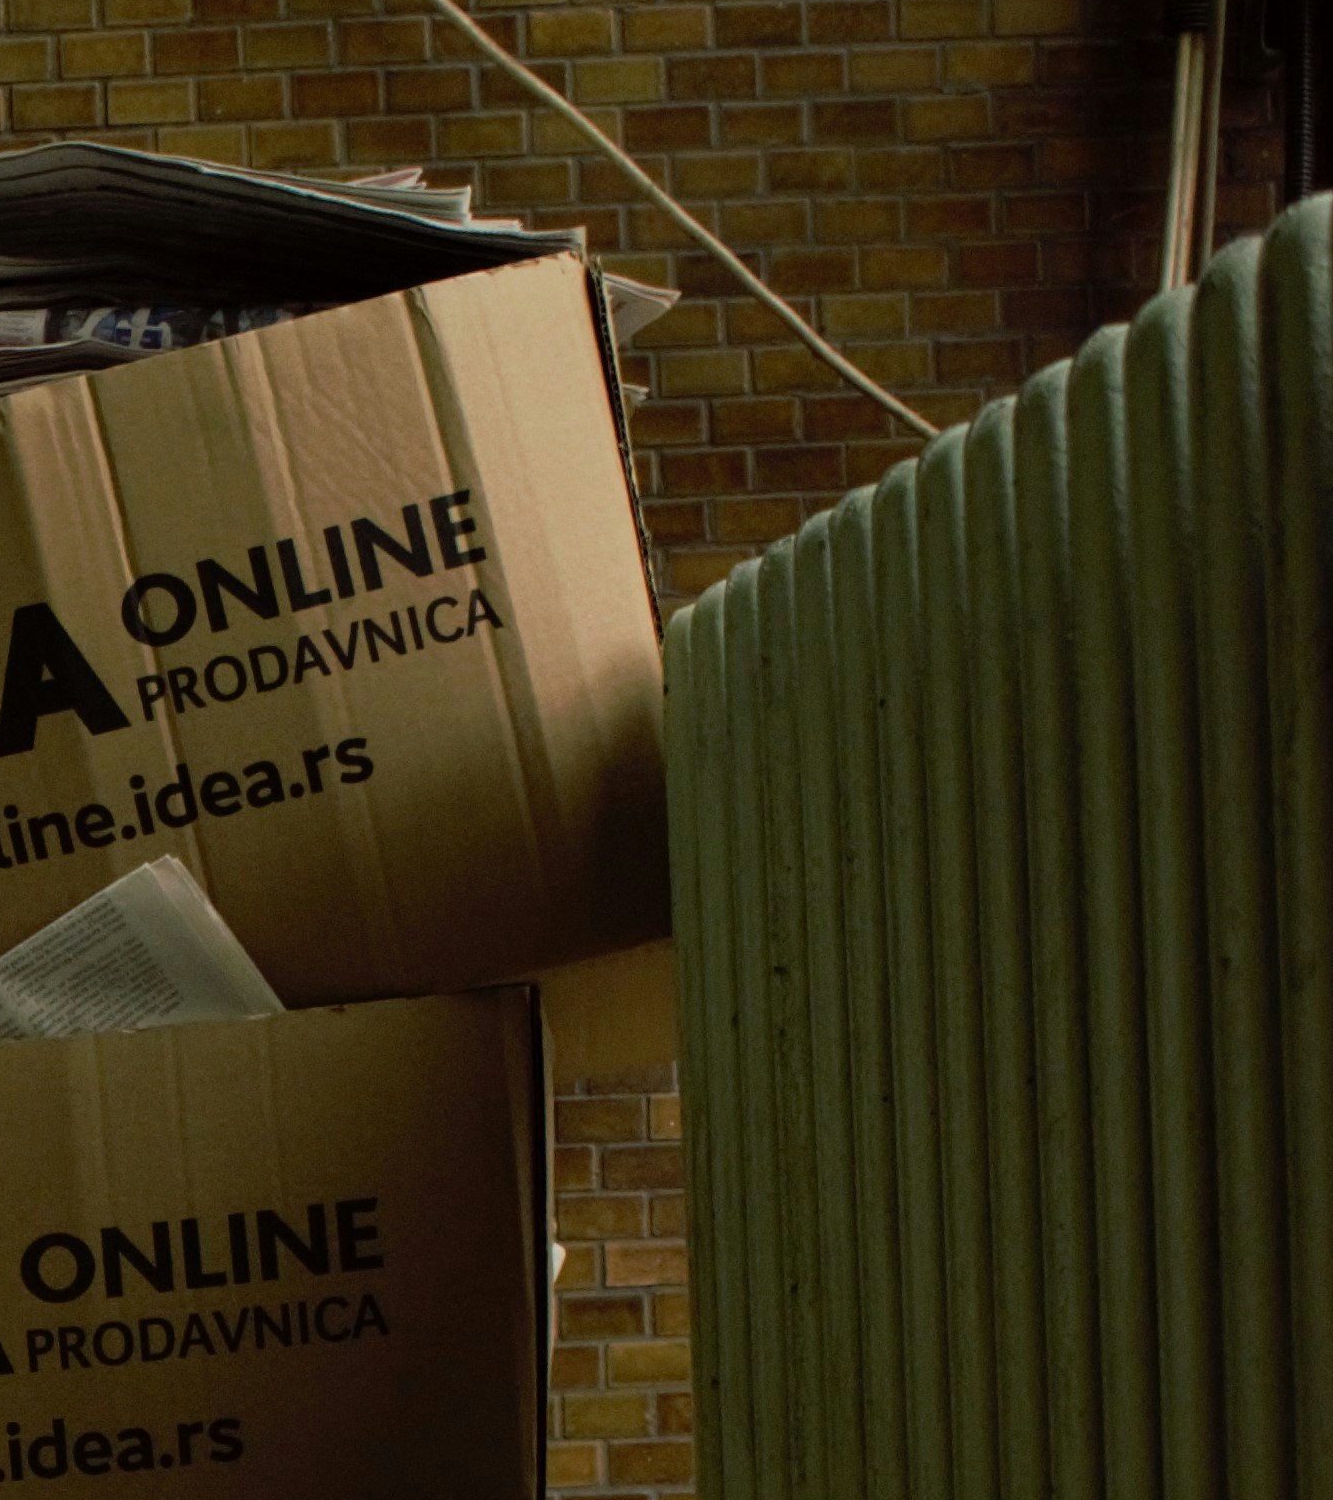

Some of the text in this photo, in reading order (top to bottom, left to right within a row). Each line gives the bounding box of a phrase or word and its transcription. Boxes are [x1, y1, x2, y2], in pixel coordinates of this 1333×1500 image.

[119, 490, 486, 648] ONLINE
[136, 587, 503, 722] PRODAVNICA
[20, 1198, 385, 1301] ONLINE
[26, 1296, 390, 1375] PRODAVNICA
